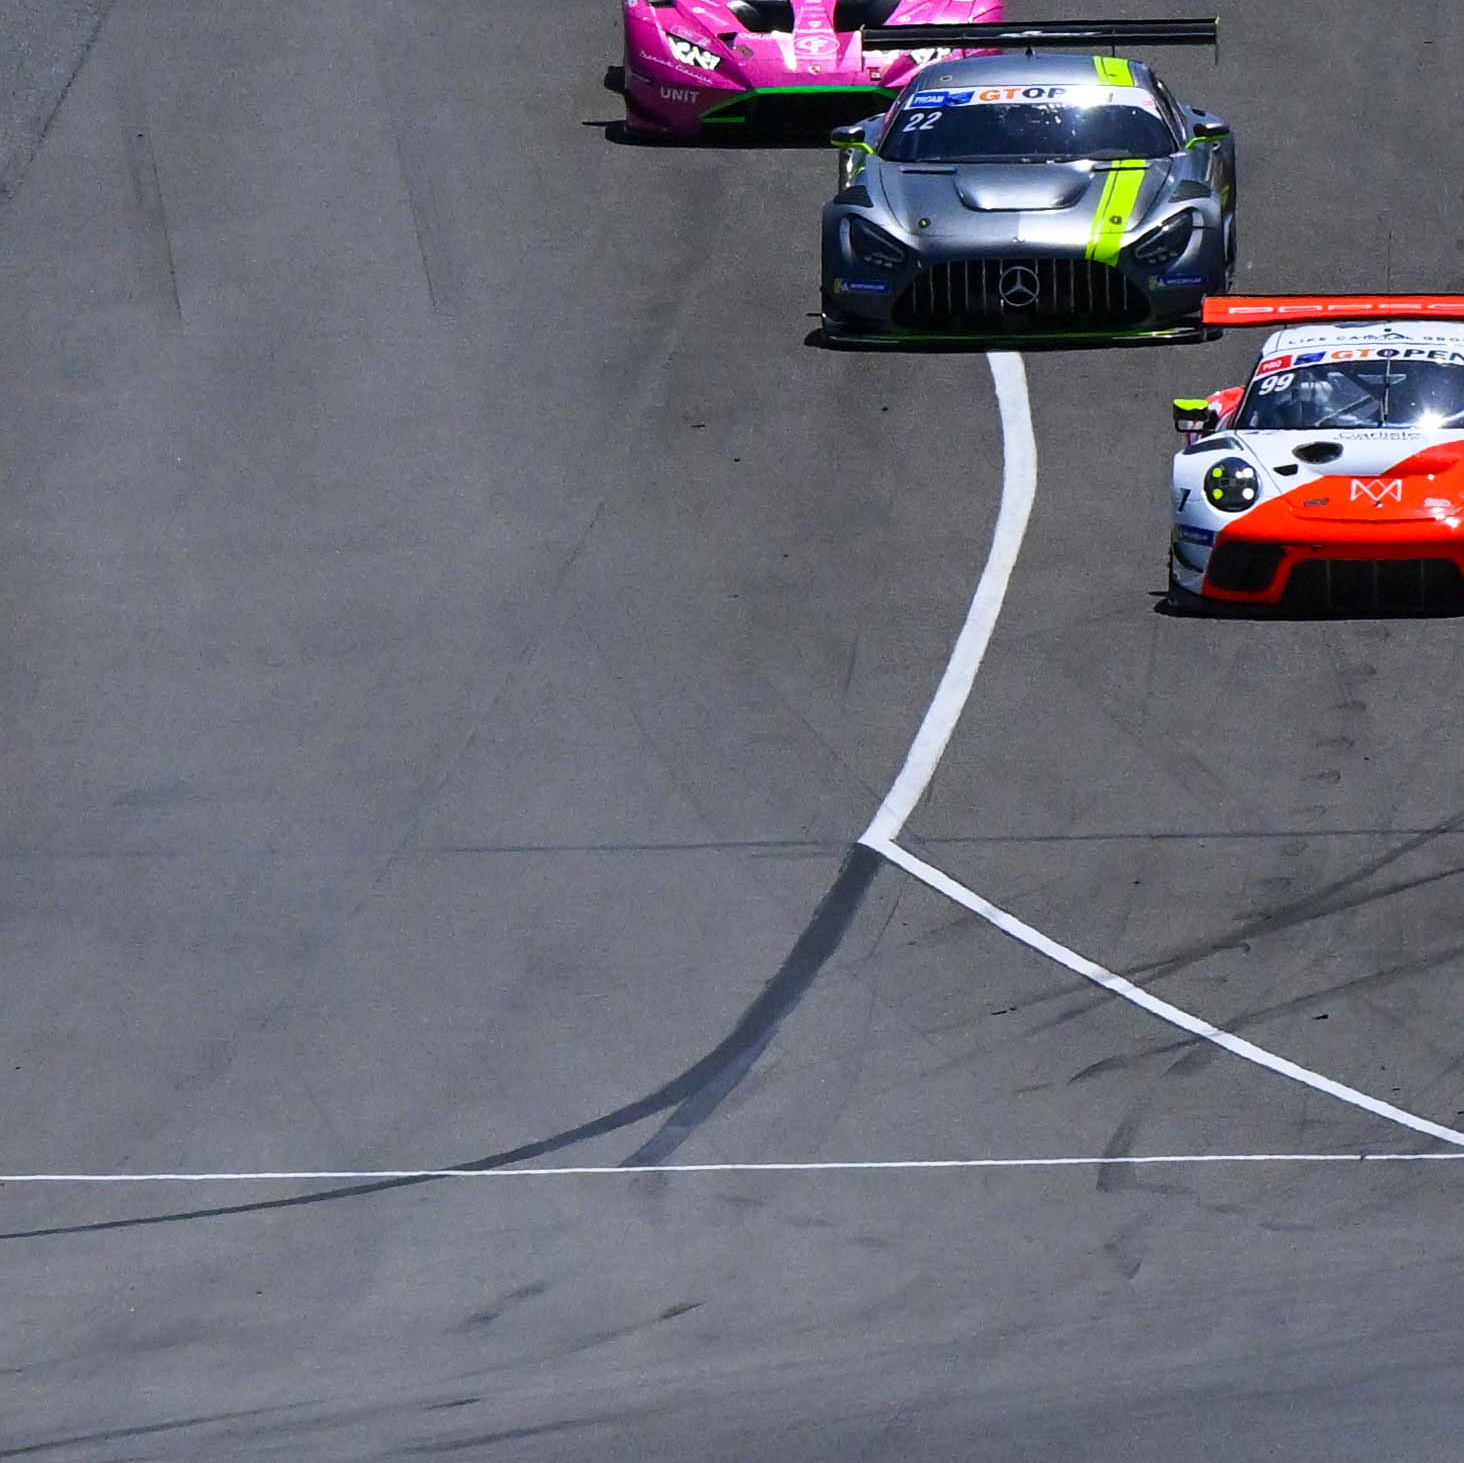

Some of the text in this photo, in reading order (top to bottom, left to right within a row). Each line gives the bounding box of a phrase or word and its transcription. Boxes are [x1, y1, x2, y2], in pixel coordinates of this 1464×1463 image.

[660, 86, 700, 104] UNIT
[902, 111, 943, 133] 22
[1258, 373, 1295, 396] 99
